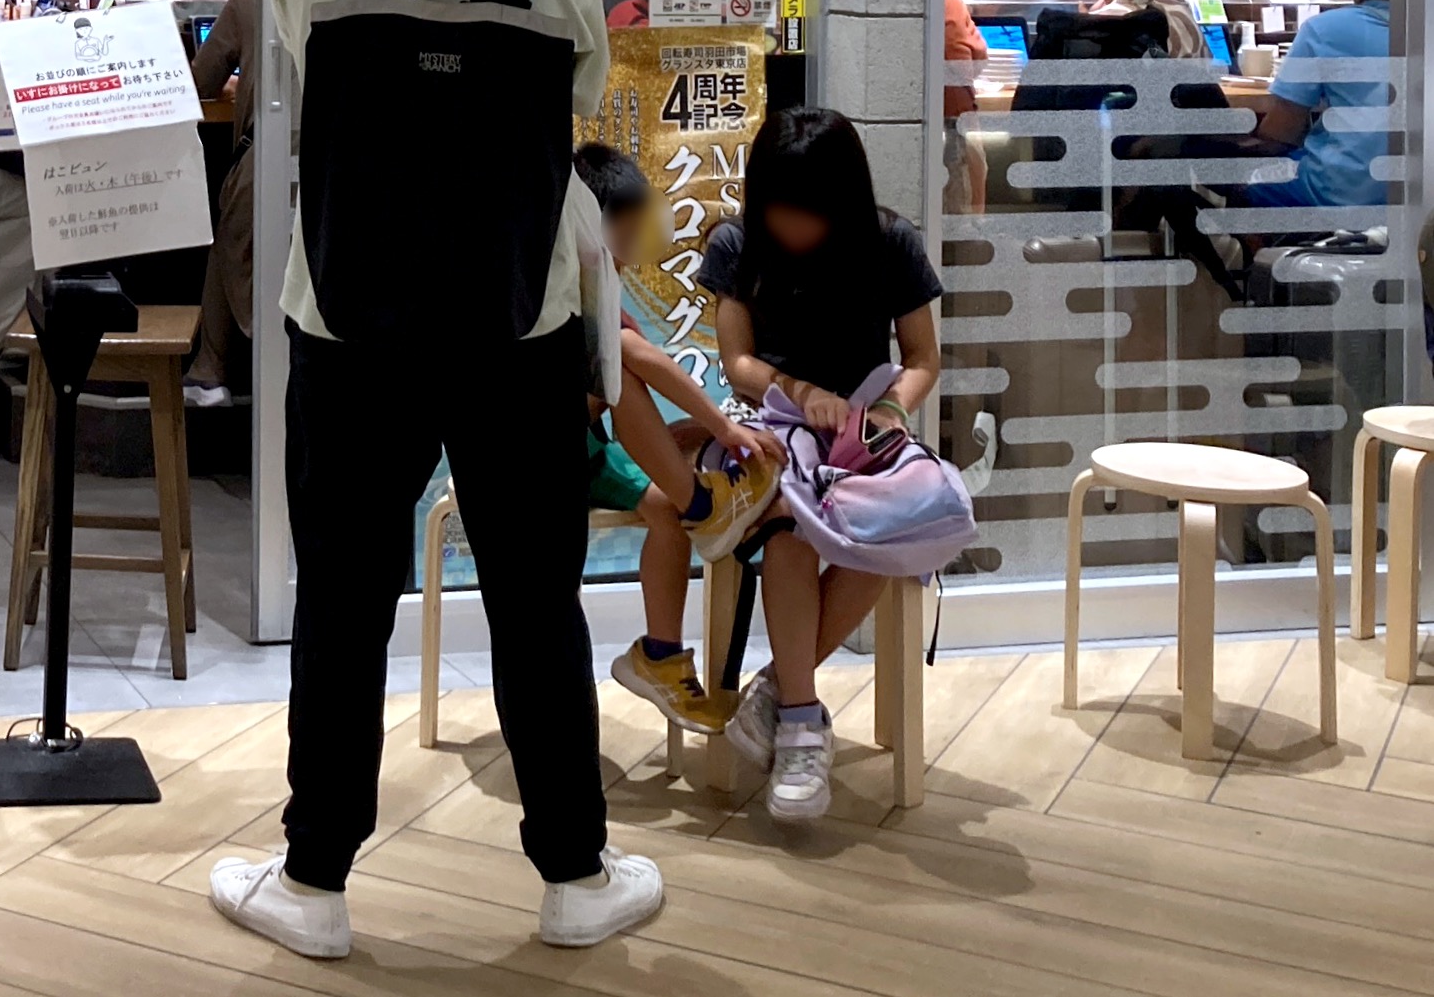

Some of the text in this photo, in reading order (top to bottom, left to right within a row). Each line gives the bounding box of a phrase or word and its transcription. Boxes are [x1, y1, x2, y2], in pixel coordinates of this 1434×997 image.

[661, 46, 747, 59] 回転寿司羽田市場
[36, 58, 156, 81] お並びの順にご案内します
[661, 58, 747, 71] グランスタ東京店
[15, 69, 184, 101] いすにお掛けになって お待ち下さい
[21, 102, 51, 114] Please
[52, 99, 73, 110] have
[81, 96, 101, 107] seat
[102, 92, 125, 104] while
[127, 89, 152, 102] you're
[153, 85, 186, 98] waiting
[693, 102, 747, 131] 記念
[44, 161, 108, 180] はこビュン
